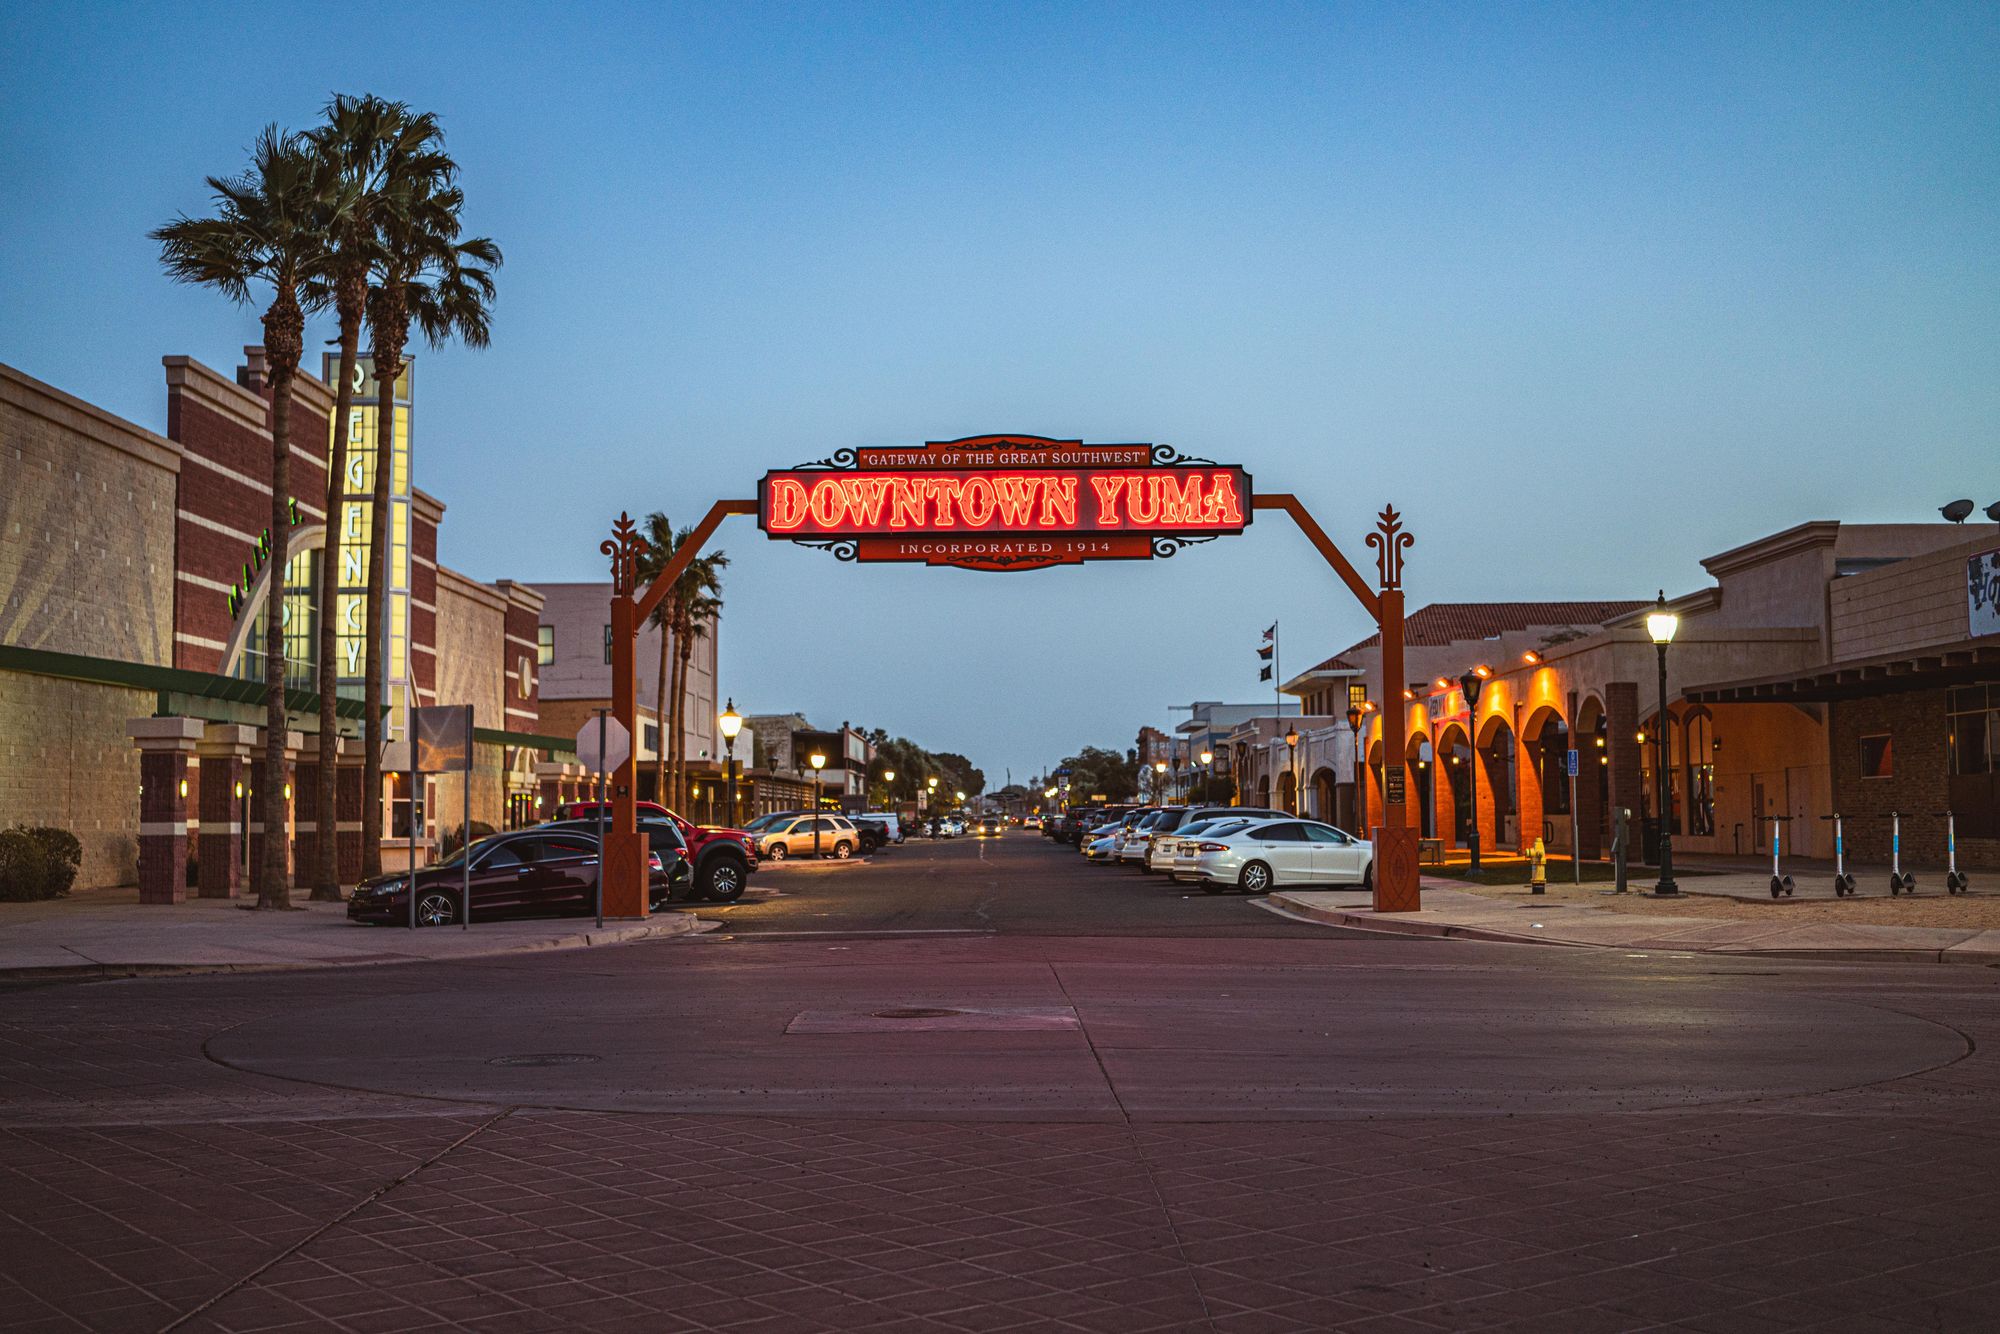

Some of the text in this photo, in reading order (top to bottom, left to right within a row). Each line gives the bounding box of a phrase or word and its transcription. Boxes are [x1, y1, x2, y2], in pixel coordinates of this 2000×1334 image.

[863, 451, 1146, 466] "GATEWAY OF THE GREAT SOUTHWEST"
[770, 475, 1242, 528] DOWNTOWN YUMA
[900, 542, 1110, 554] INCORPORATED 1914
